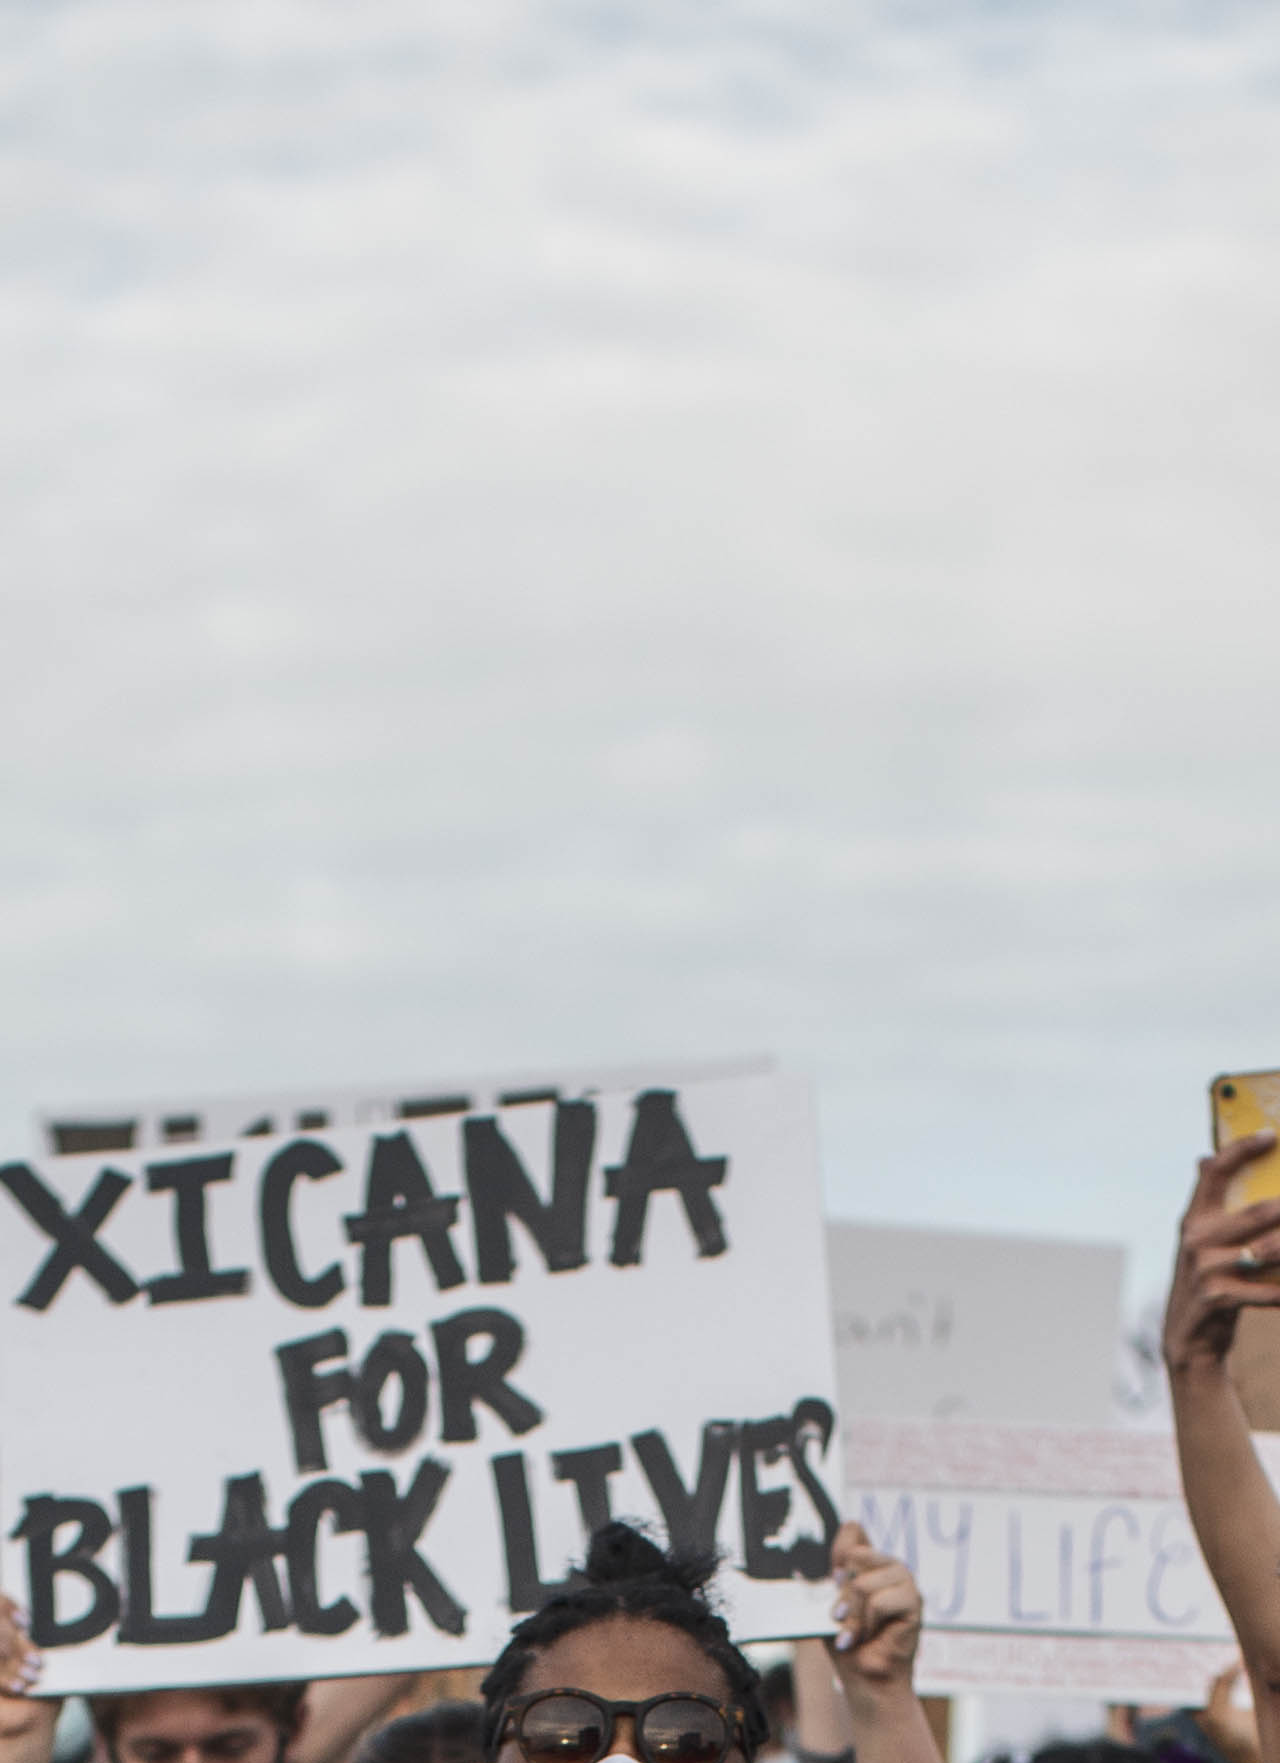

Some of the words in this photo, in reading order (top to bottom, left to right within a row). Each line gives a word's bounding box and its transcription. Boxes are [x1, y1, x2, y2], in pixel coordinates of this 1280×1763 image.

[274, 1306, 546, 1474] FOR
[8, 1455, 468, 1650] BLACK
[488, 1396, 844, 1614] LIVES
